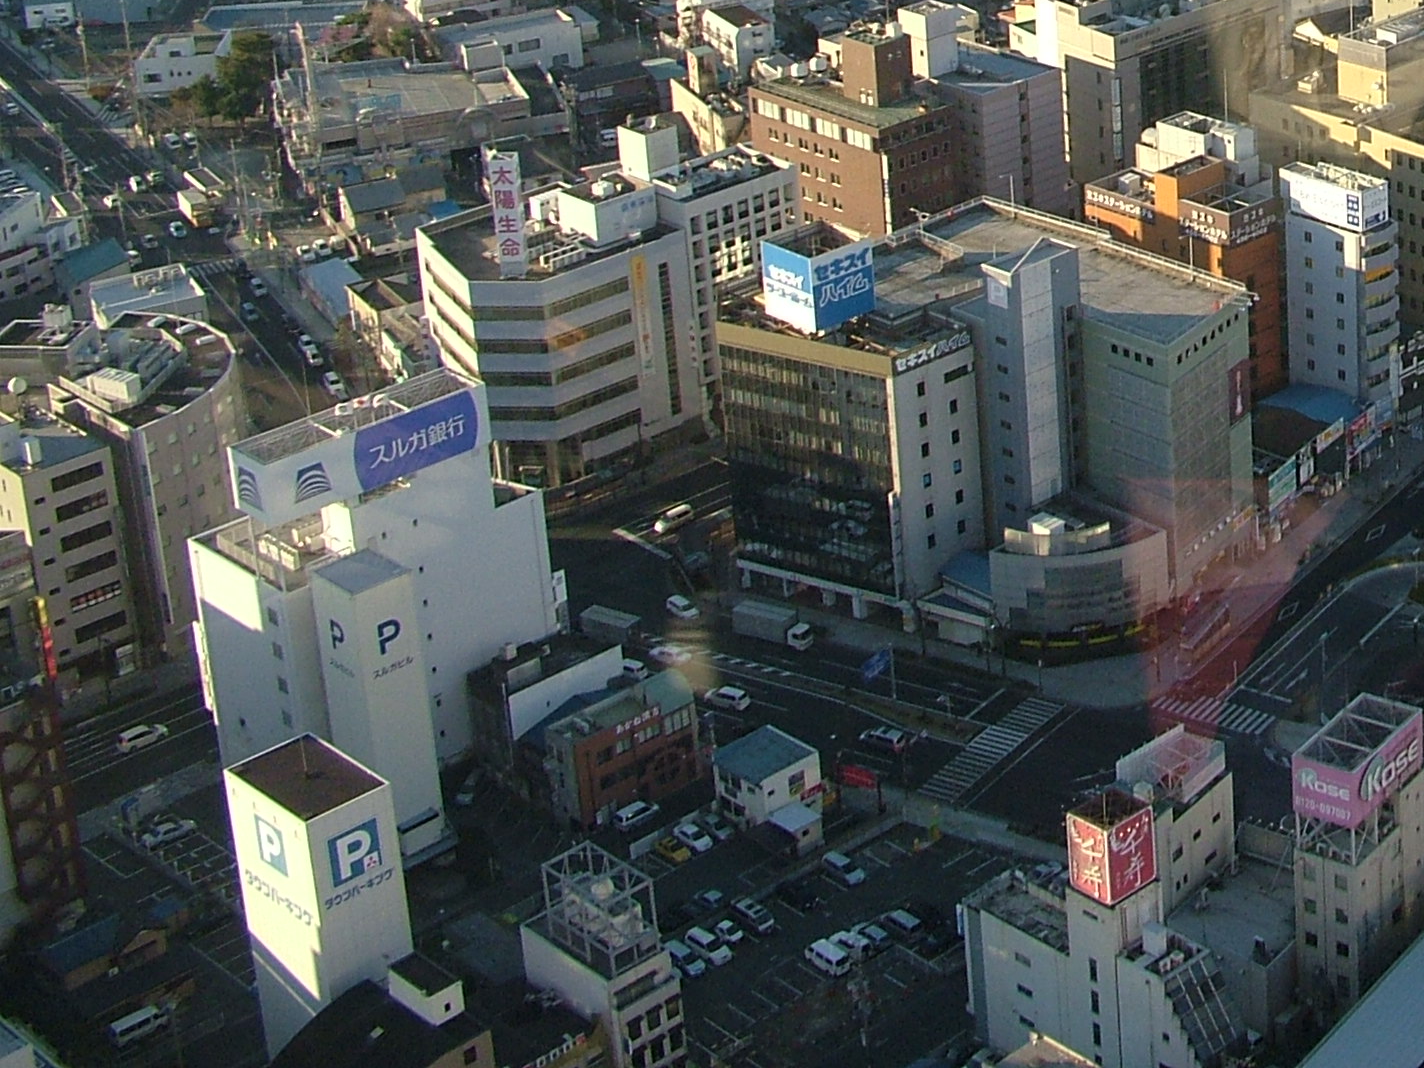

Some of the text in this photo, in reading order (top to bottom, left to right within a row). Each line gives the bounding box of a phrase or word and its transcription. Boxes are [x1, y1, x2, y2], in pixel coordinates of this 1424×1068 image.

[491, 165, 520, 257] 太陽生命
[814, 247, 870, 280] セキスイ
[819, 272, 869, 309] ハイム
[895, 331, 971, 372] セキスイハイム
[368, 412, 466, 470] スルガ銀行
[329, 618, 345, 650] P
[377, 618, 402, 656] P
[258, 818, 281, 864] P
[335, 830, 372, 881] P
[245, 868, 314, 927] タウンパーキング
[324, 867, 394, 910] タウンパーキング
